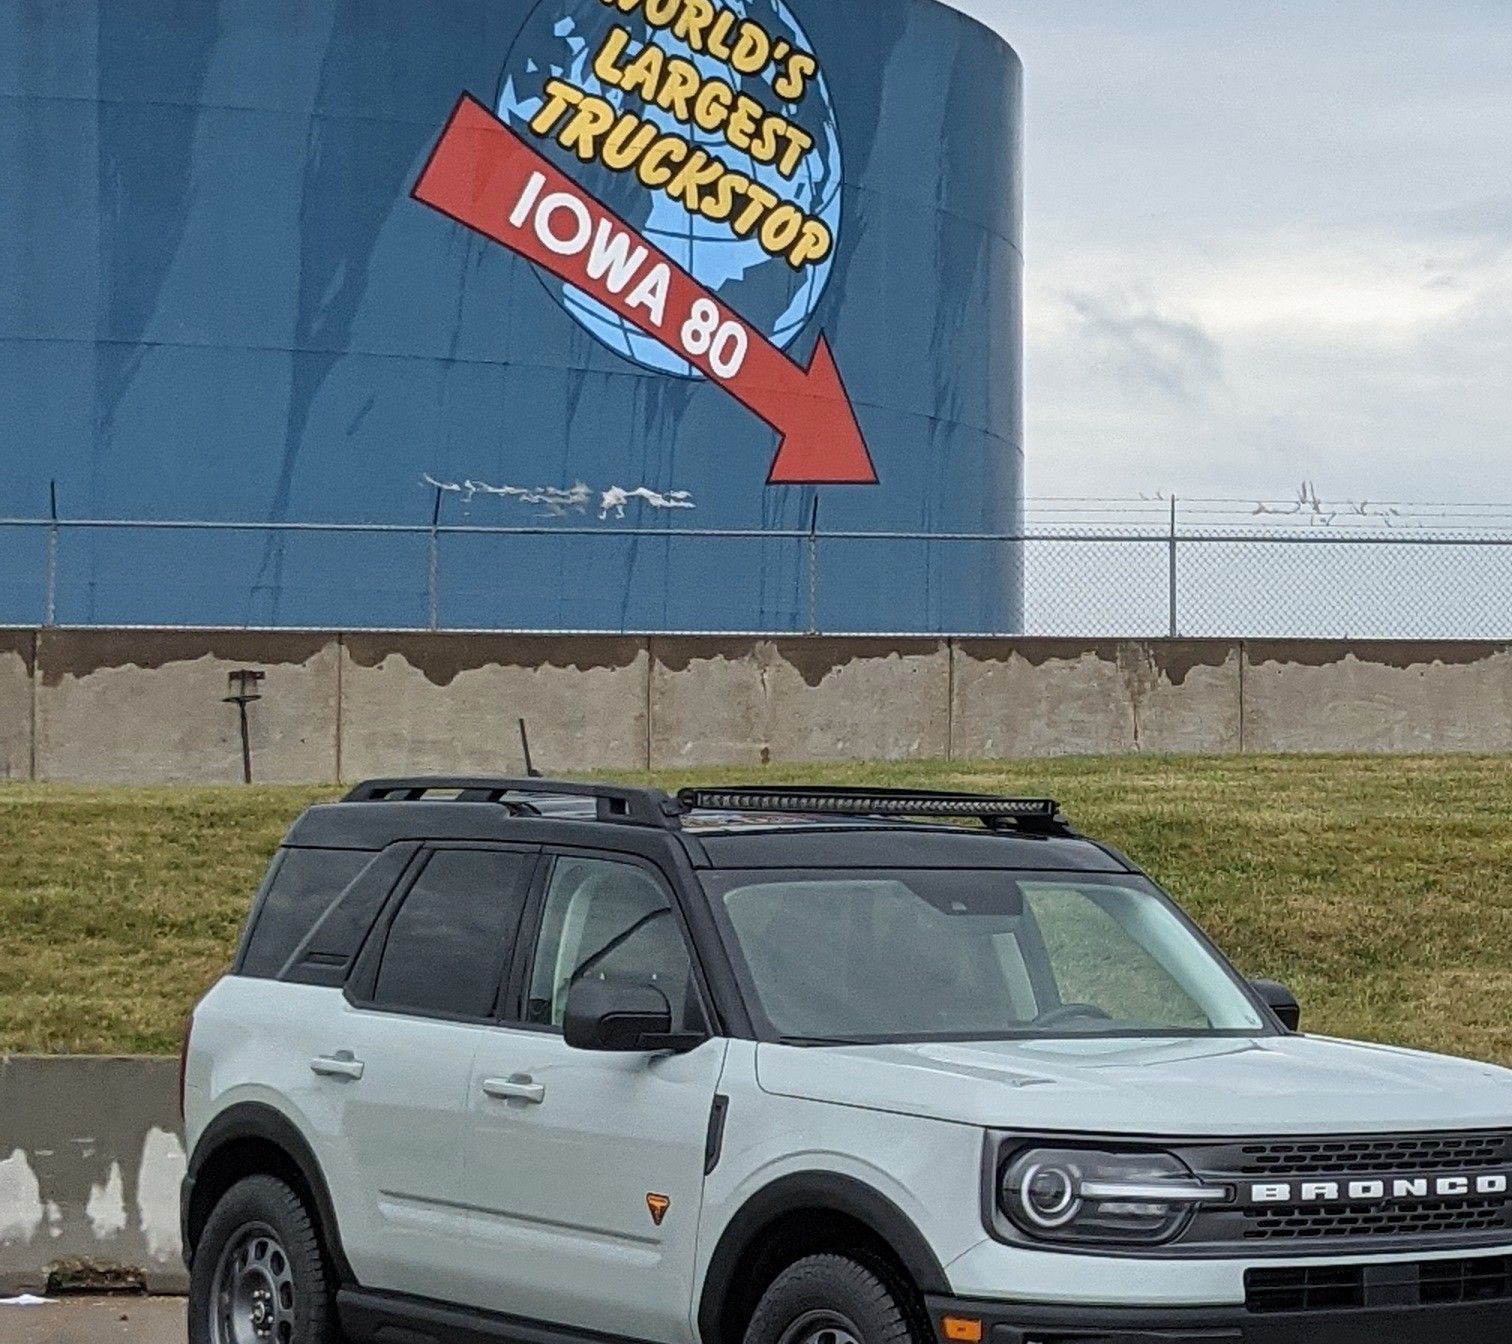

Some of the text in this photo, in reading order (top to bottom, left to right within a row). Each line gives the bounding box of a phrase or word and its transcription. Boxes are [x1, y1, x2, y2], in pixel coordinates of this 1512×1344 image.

[529, 78, 830, 269] TRUCKSTOP
[594, 26, 812, 176] LARGEST
[509, 171, 748, 379] IOWA 80
[1251, 1175, 1507, 1202] BRONCO
